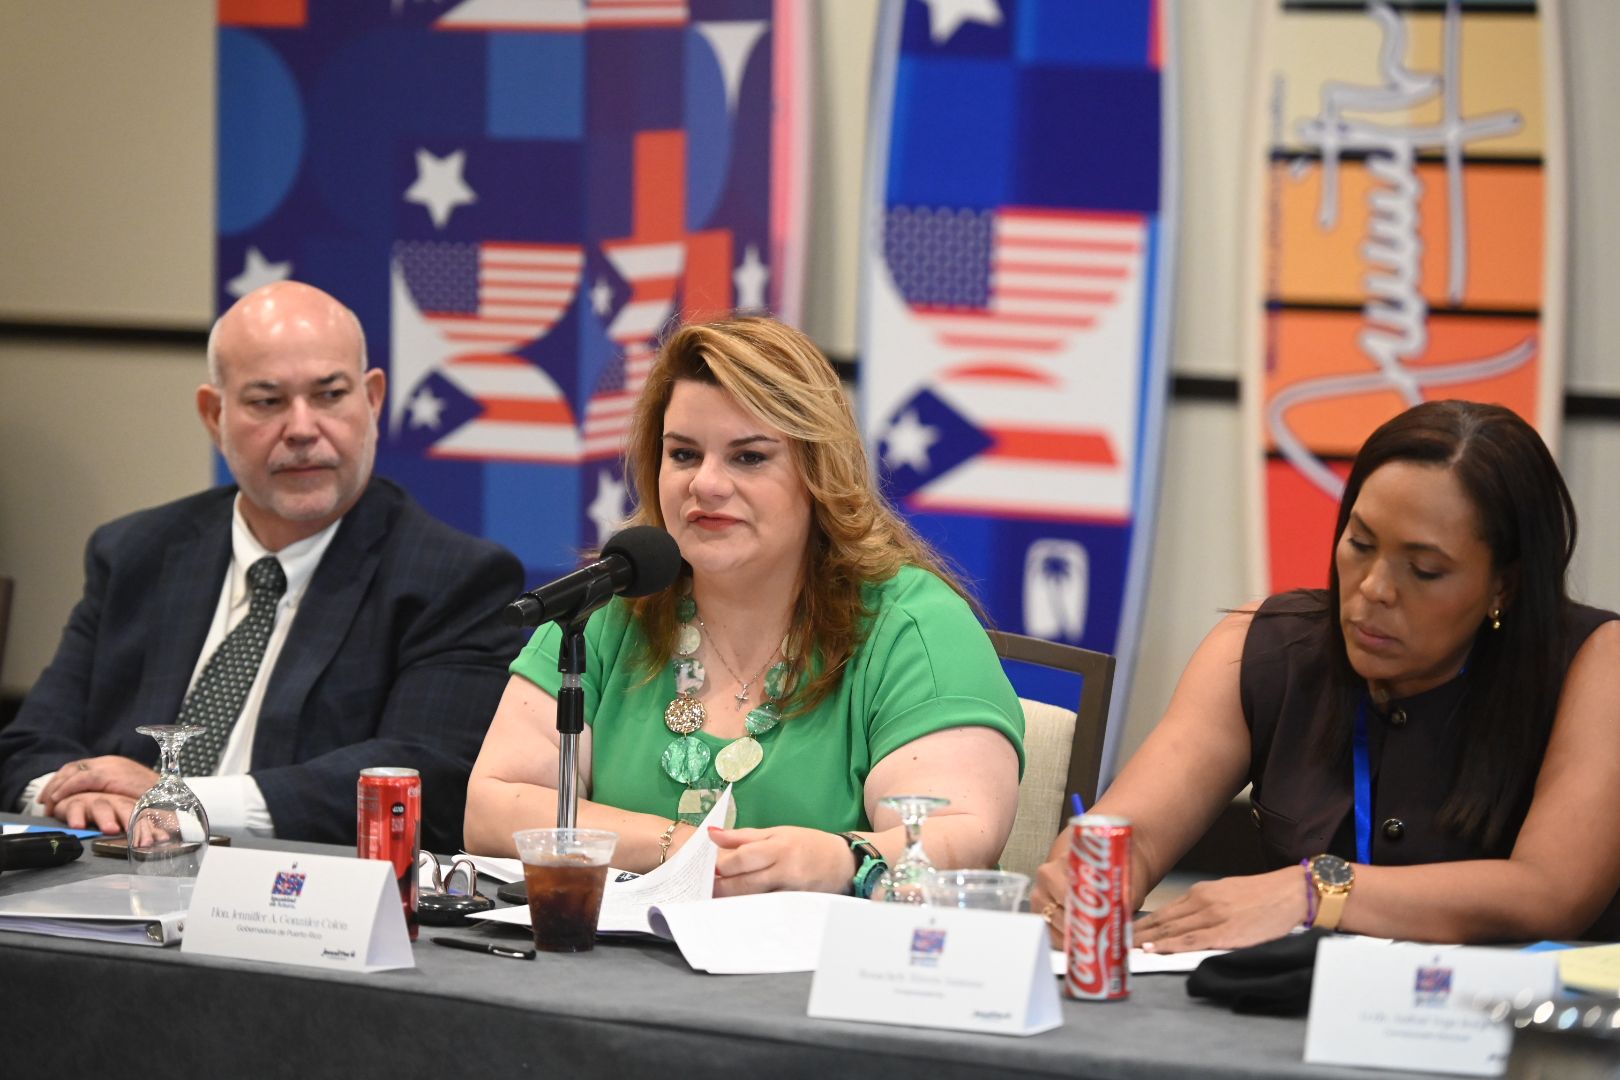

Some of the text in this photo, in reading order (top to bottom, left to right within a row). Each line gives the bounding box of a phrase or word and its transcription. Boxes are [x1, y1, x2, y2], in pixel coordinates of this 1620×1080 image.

[231, 909, 267, 923] Jennifer
[236, 923, 276, 935] Gobernadora
[286, 928, 307, 939] Puerto
[308, 930, 323, 941] Rico
